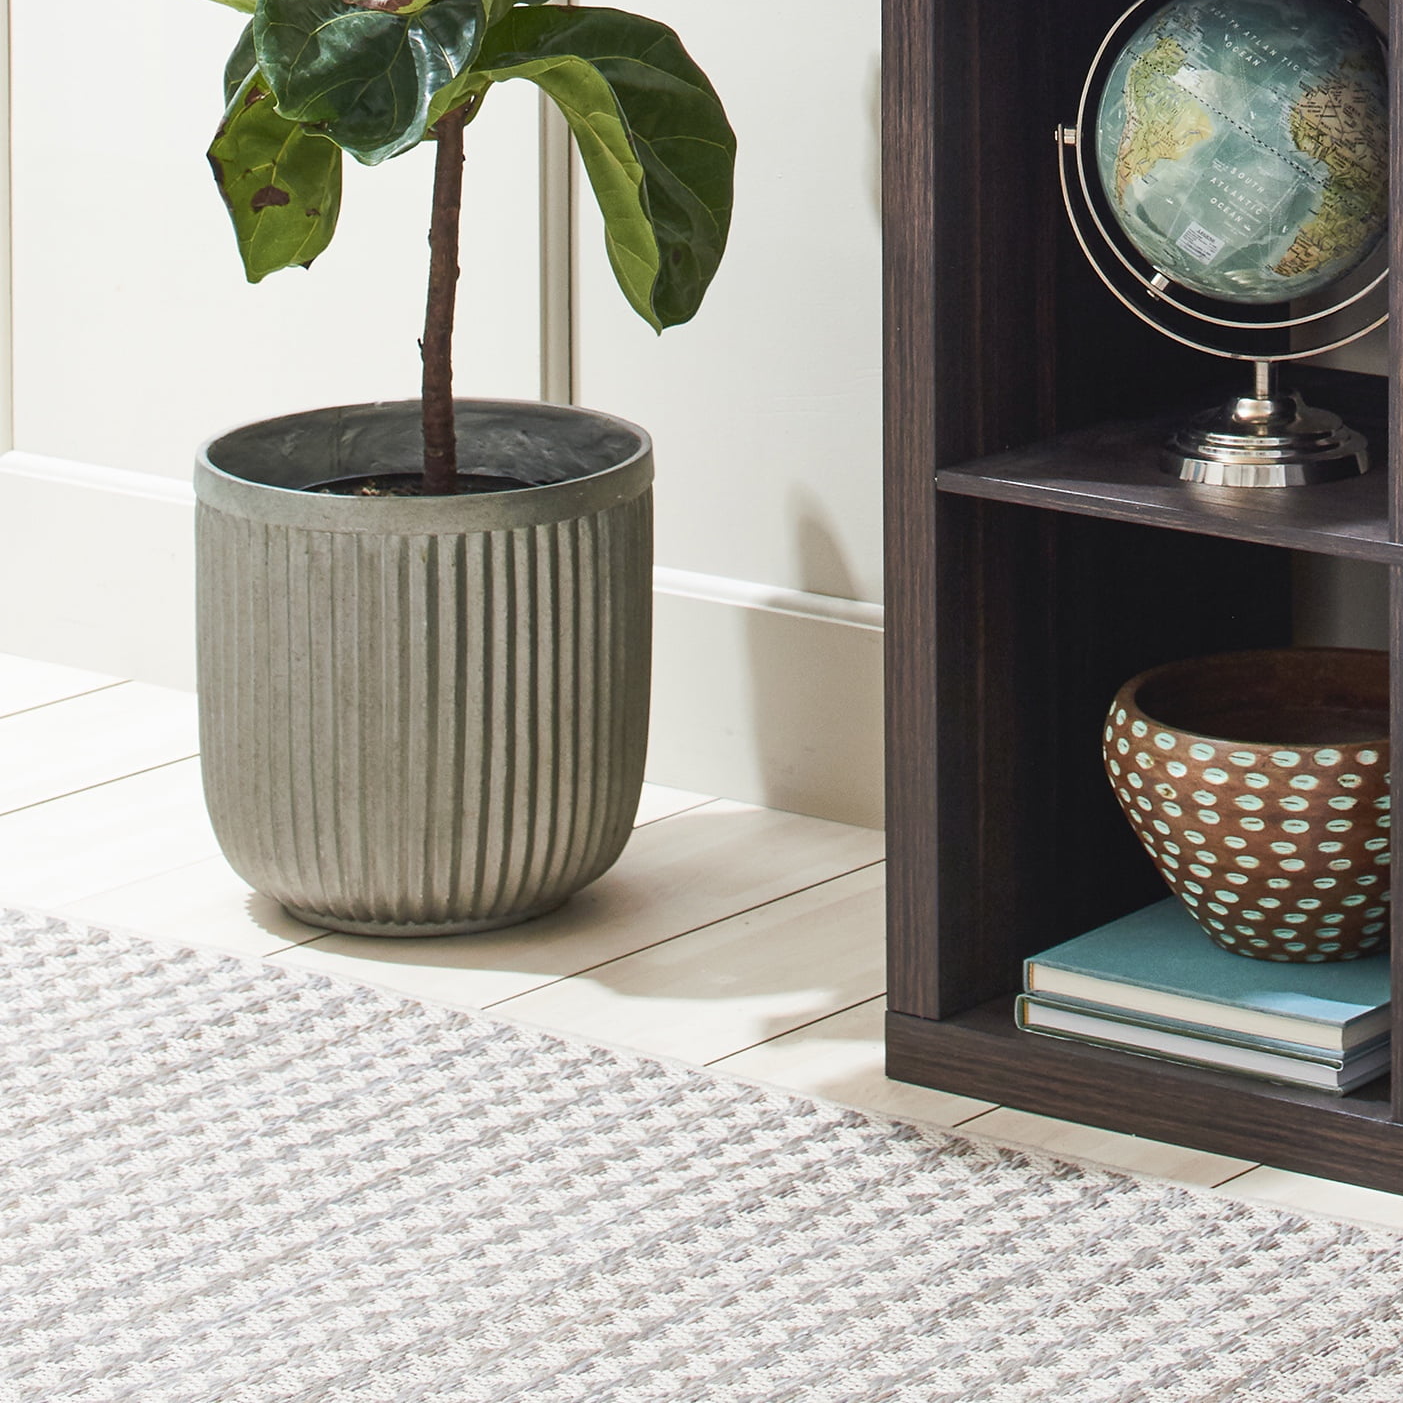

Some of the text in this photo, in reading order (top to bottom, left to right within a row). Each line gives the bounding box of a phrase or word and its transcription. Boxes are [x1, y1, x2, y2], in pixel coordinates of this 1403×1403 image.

[1225, 41, 1261, 67] OCEAN
[1230, 167, 1265, 194] SOUTH
[1210, 177, 1263, 215] ATLANTIC
[1210, 197, 1244, 223] OCEAN
